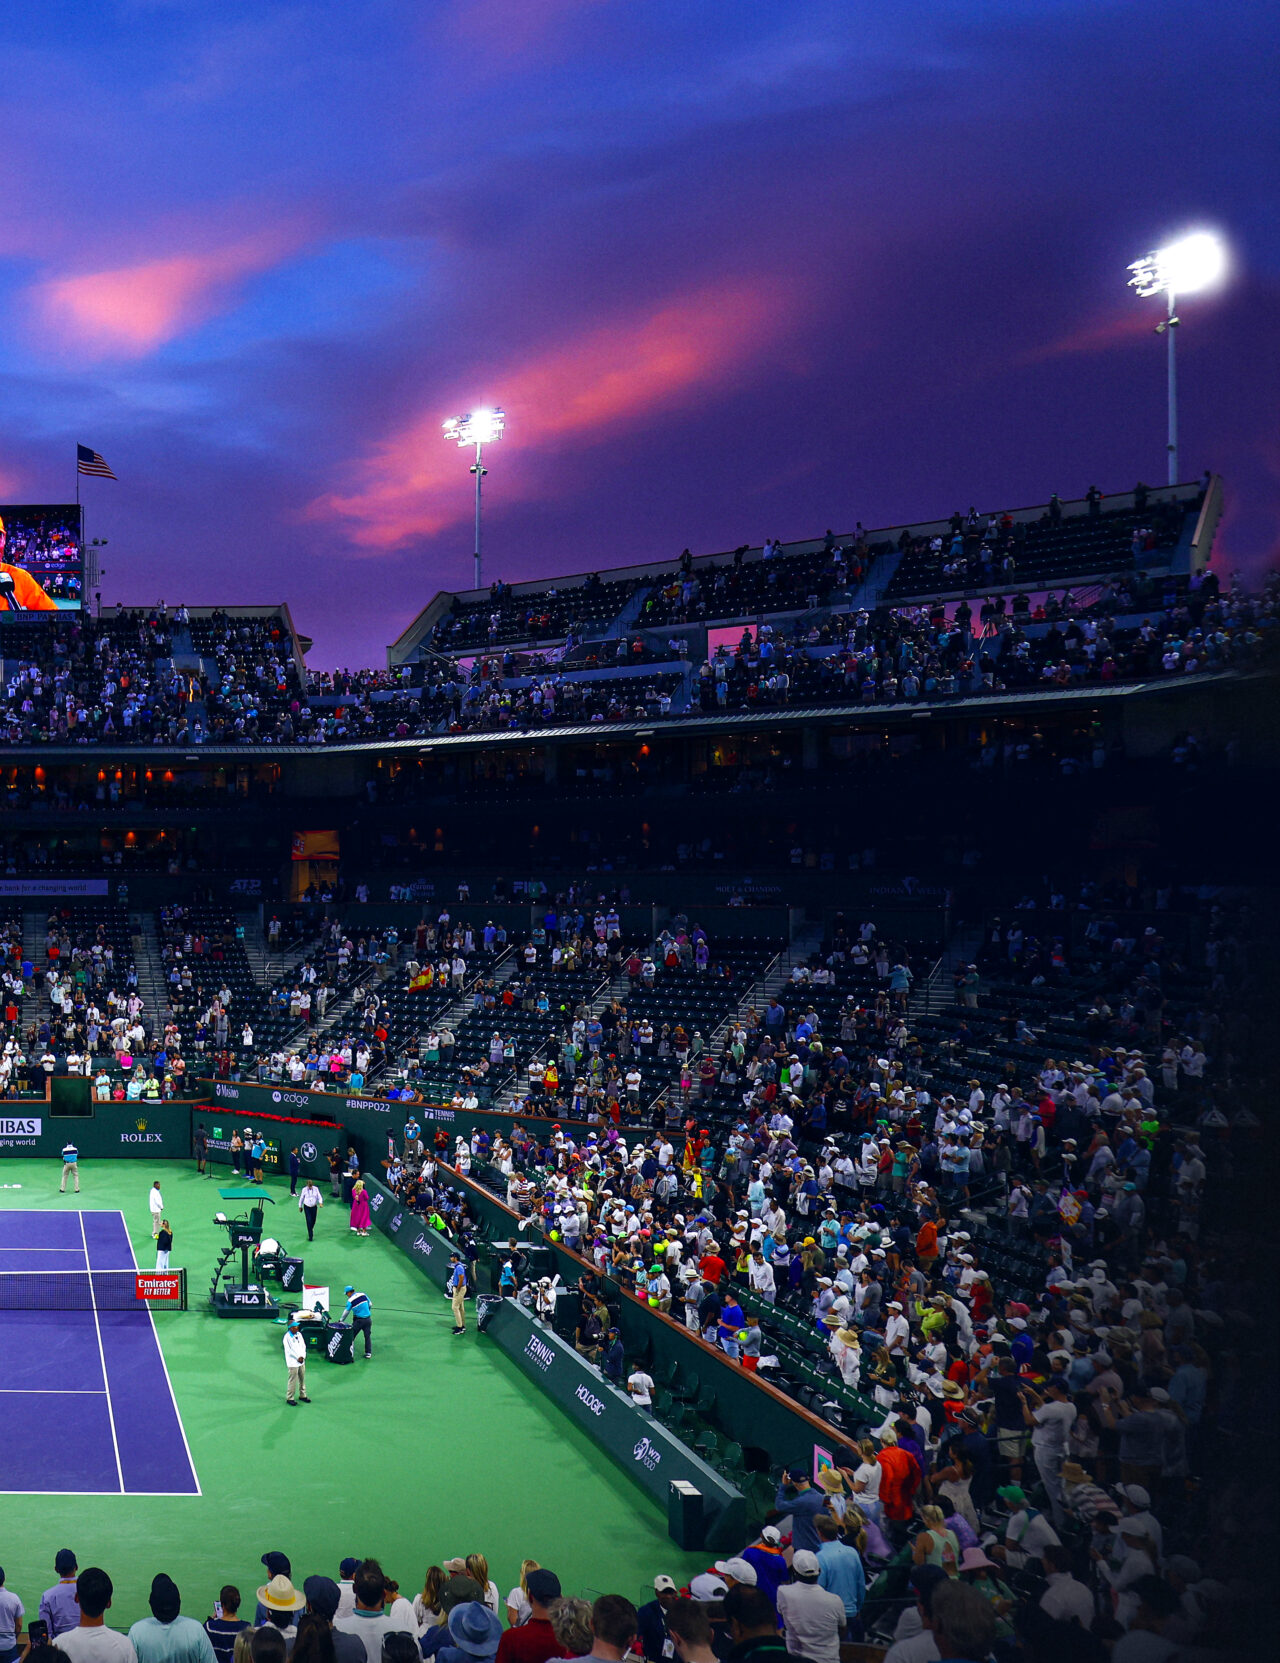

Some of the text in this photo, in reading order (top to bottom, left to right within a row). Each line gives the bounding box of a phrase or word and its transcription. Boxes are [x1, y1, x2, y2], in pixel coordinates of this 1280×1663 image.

[283, 1093, 310, 1108] edge
[434, 1109, 455, 1118] TENNIS
[15, 1138, 36, 1146] world
[120, 1133, 163, 1143] ROLEX
[138, 1279, 177, 1288] Emirates
[282, 1264, 296, 1288] penn
[143, 1288, 172, 1296] FLY BETTER
[233, 1294, 260, 1304] FILA
[327, 1331, 343, 1358] penn
[527, 1333, 555, 1366] TENNIS
[523, 1346, 549, 1372] WAREHOUSE
[574, 1383, 605, 1416] HOLOGIC
[648, 1446, 661, 1464] WTA
[642, 1455, 656, 1471] 1000
